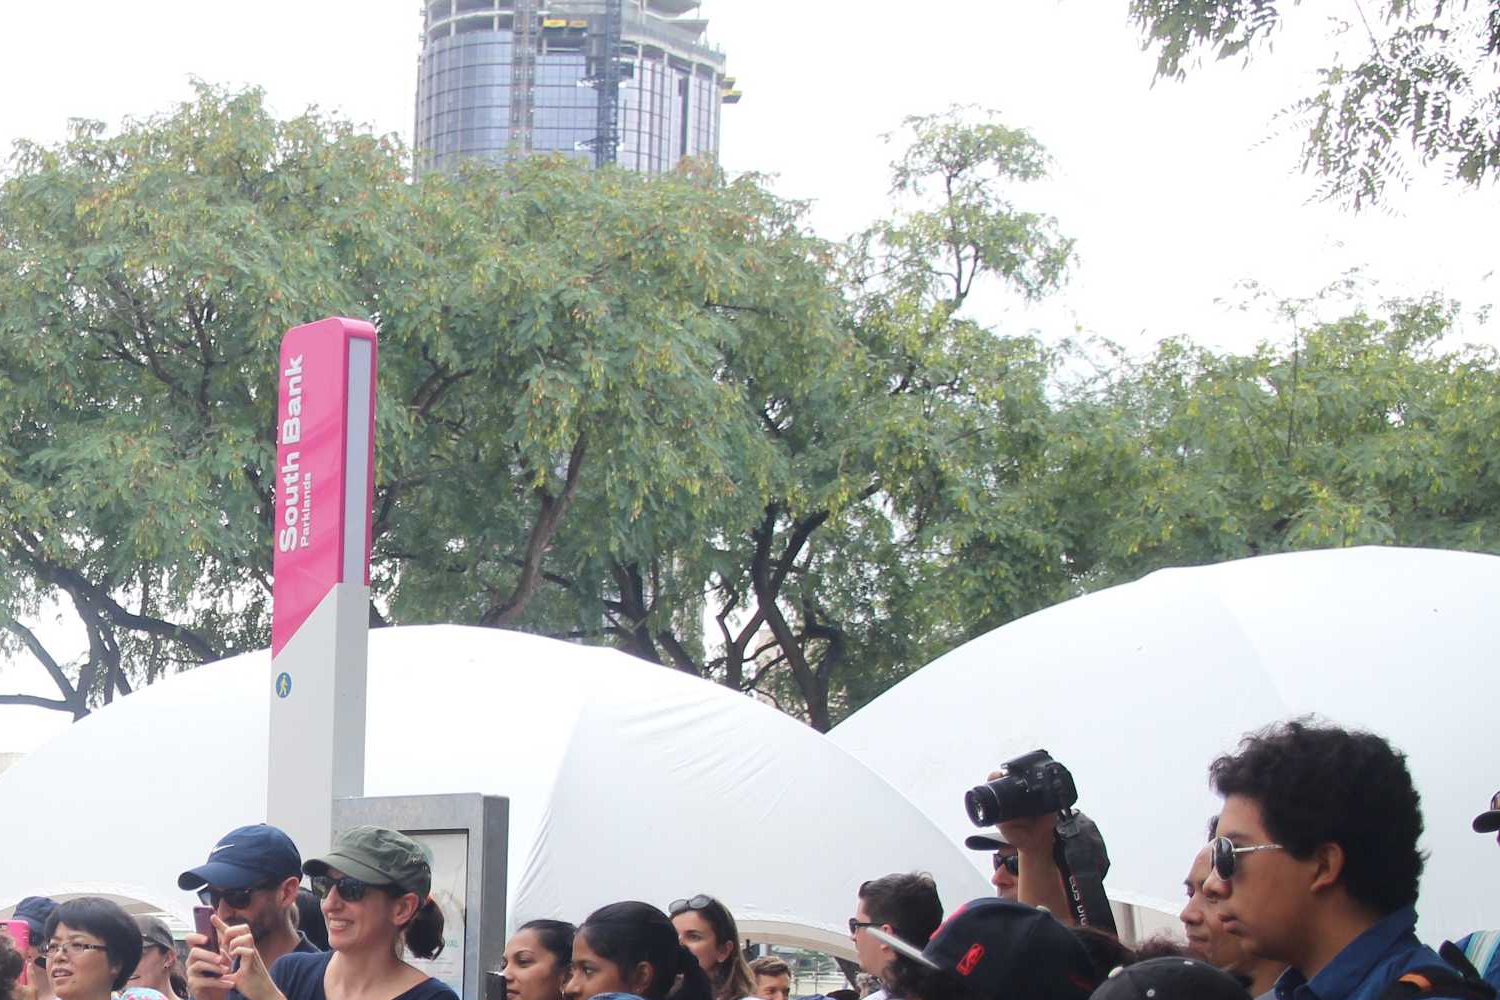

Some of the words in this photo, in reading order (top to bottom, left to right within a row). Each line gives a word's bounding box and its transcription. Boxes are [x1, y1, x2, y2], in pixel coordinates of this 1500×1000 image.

[283, 354, 303, 445] Bank
[279, 451, 299, 552] South
[301, 472, 312, 548] Parklands
